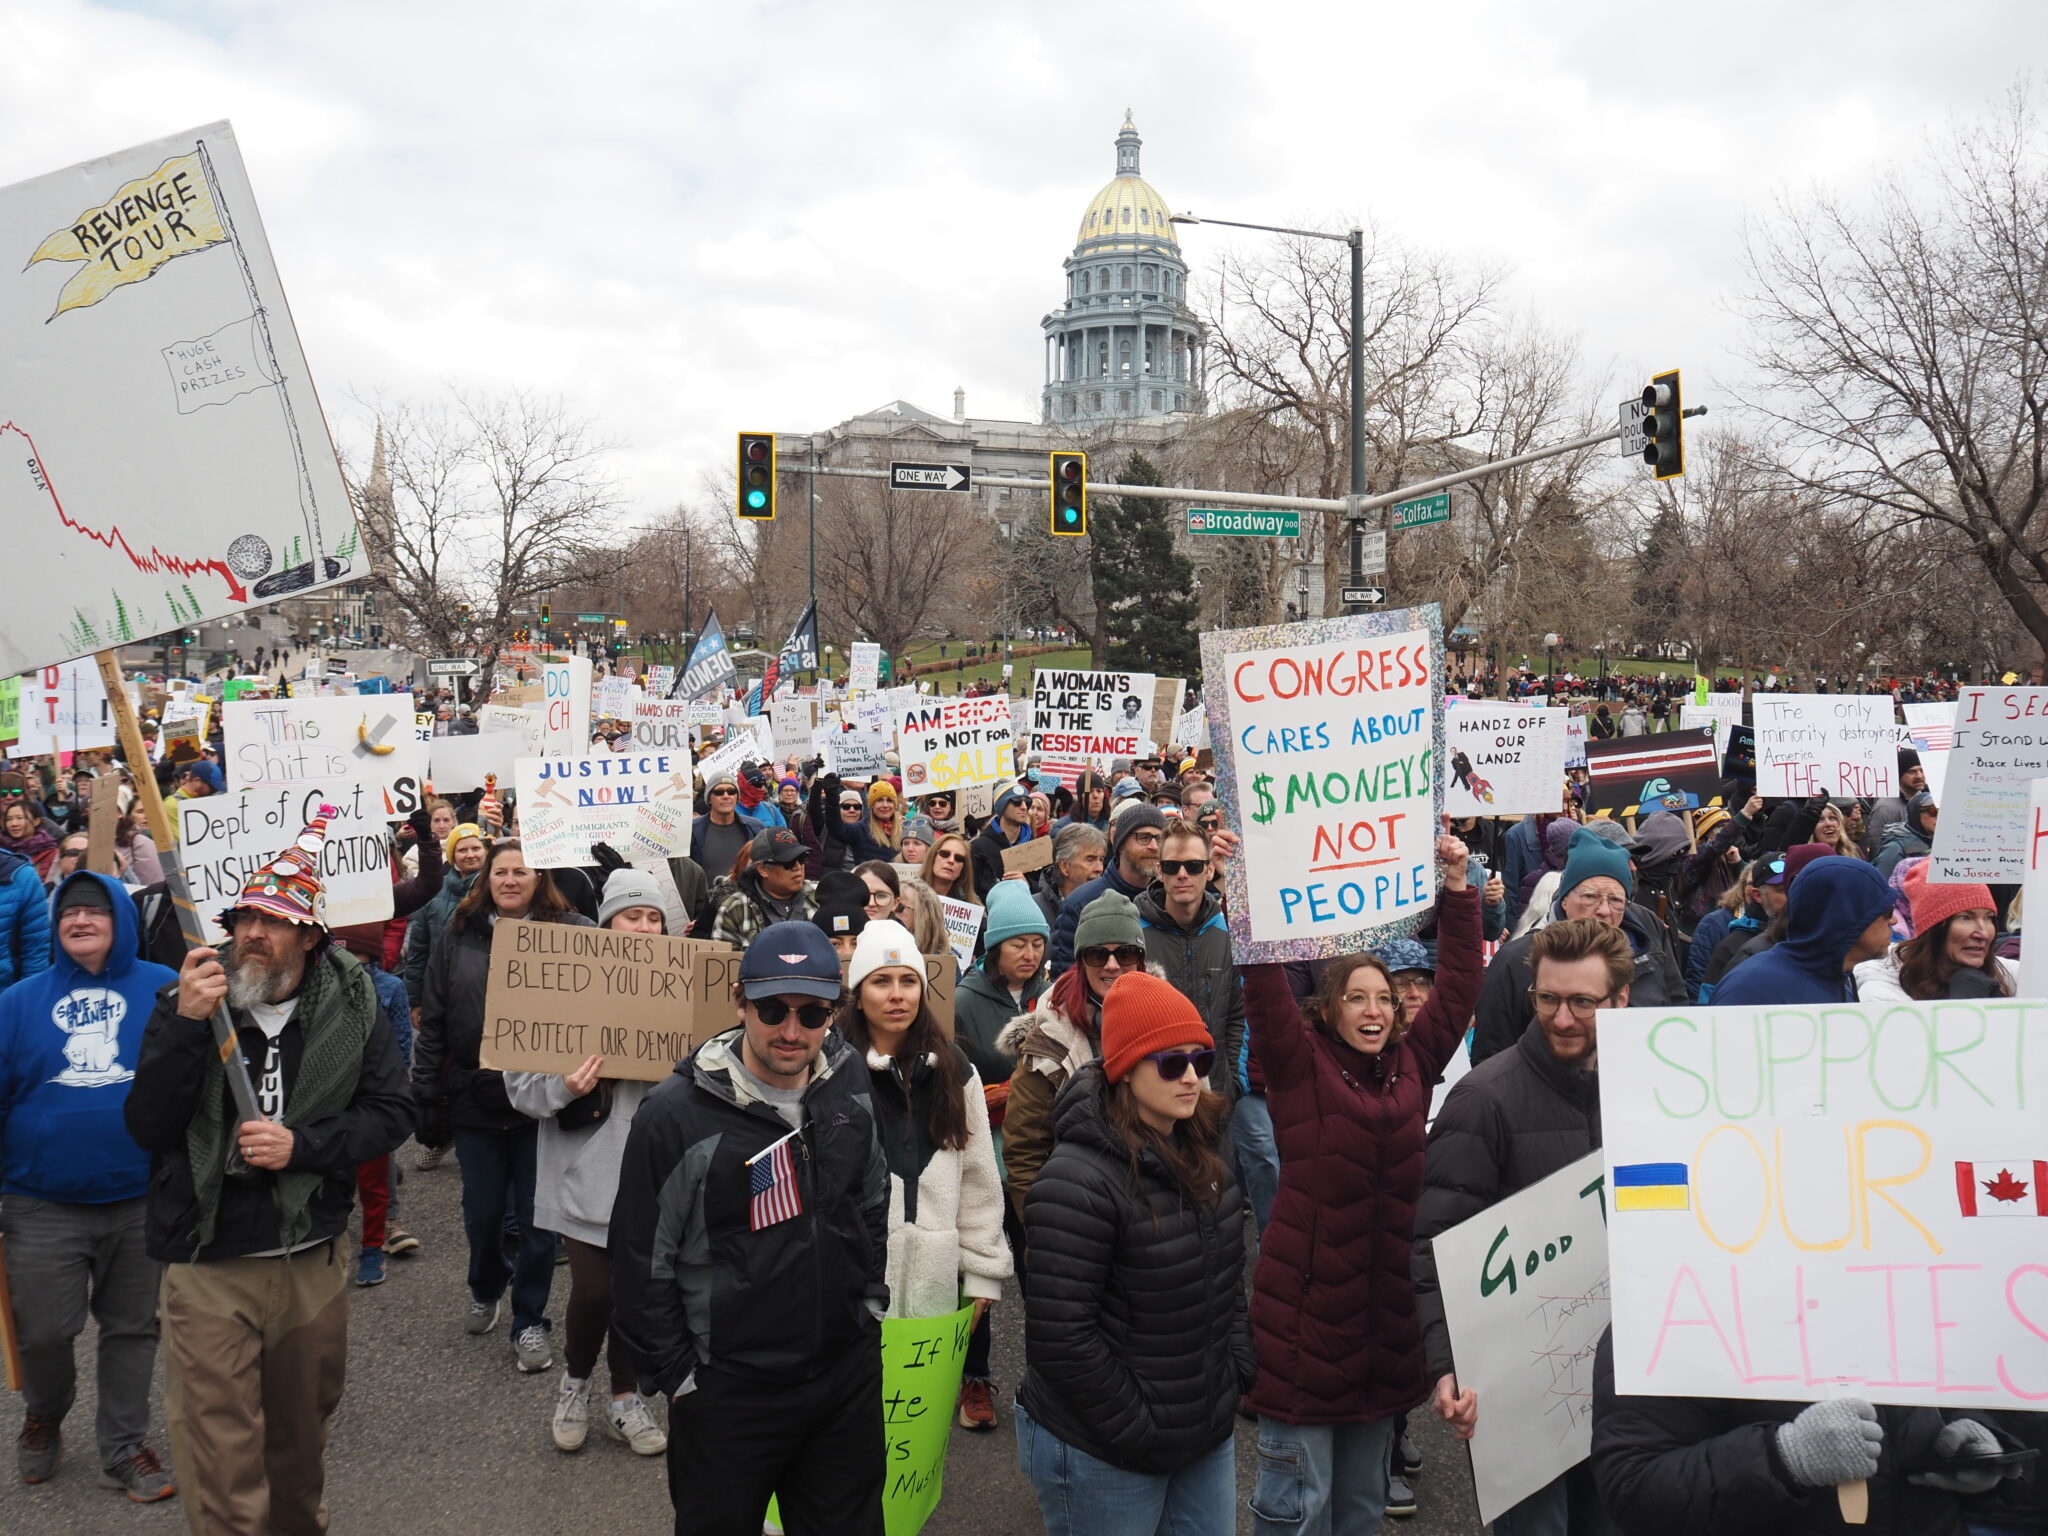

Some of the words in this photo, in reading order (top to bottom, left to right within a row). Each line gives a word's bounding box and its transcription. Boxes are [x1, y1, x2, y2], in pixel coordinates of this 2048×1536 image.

[71, 172, 197, 253] REVENGE
[183, 356, 222, 376] CASH
[181, 366, 246, 394] PRIZES
[1624, 423, 1643, 438] DOU
[899, 471, 920, 481] ONE
[925, 472, 946, 482] WAY
[1206, 513, 1284, 535] Broadway
[1403, 503, 1432, 524] Colfax
[1036, 672, 1047, 690] A
[1052, 672, 1130, 693] WOMAN'S
[1234, 645, 1429, 702] CONGRESS
[636, 703, 662, 717] HANDS
[666, 705, 683, 717] OFF
[1035, 691, 1089, 710] PLACE
[1096, 693, 1112, 711] IS
[1762, 702, 1804, 720] The
[1834, 698, 1872, 723] only
[1966, 693, 1985, 722] I
[254, 710, 319, 746] This
[904, 700, 1011, 734] AMERICA
[1035, 711, 1051, 728] IN
[1059, 712, 1093, 730] THE
[1460, 718, 1511, 733] HANDZ
[1517, 717, 1547, 729] OFF
[637, 721, 681, 748] OUR
[829, 736, 848, 746] Walk
[925, 738, 938, 752] IS
[946, 729, 981, 748] NOT
[986, 729, 1010, 742] FOR
[1242, 722, 1330, 754] CARES
[1351, 708, 1425, 745] ABOUT
[1496, 736, 1525, 748] OUR
[1763, 725, 1827, 747] minority
[1840, 724, 1895, 743] destroying
[1953, 731, 1970, 748] I
[1031, 733, 1138, 755] RESISTANCE
[239, 744, 308, 782] Shit
[326, 755, 346, 774] is
[539, 756, 670, 779] JUSTICE
[930, 743, 1015, 791] $ALE
[1477, 752, 1521, 765] LANDZ
[1764, 747, 1814, 765] America
[1864, 747, 1873, 759] is
[2014, 758, 2041, 768] Lives
[1251, 742, 1432, 825] $MONEY$
[1773, 762, 1824, 797] THE
[1839, 761, 1888, 797] RICH
[184, 796, 250, 849] Dept
[265, 791, 289, 828] of
[635, 806, 673, 831] MEDICARE
[655, 801, 682, 817] HANDS
[524, 819, 565, 841] MEDICAID
[571, 821, 629, 833] IMMIGRANTS
[1313, 813, 1406, 863] NOT
[633, 831, 672, 857] EDUCATION
[186, 832, 389, 904] ENSHITICATION
[1280, 864, 1428, 924] PEOPLE
[945, 904, 972, 920] WHEN
[944, 919, 978, 936] NJUSTICE
[517, 926, 654, 964] BILLIONAIRES
[507, 960, 591, 993] BLEED
[601, 965, 639, 996] YOU
[650, 970, 694, 1002] DRY
[57, 997, 90, 1018] SAVE
[495, 1018, 589, 1055] PROTECT
[601, 1026, 628, 1056] OUR
[1646, 1002, 2048, 1119] SUPPORT
[1691, 1118, 1944, 1257] OUR
[904, 1337, 942, 1369] If
